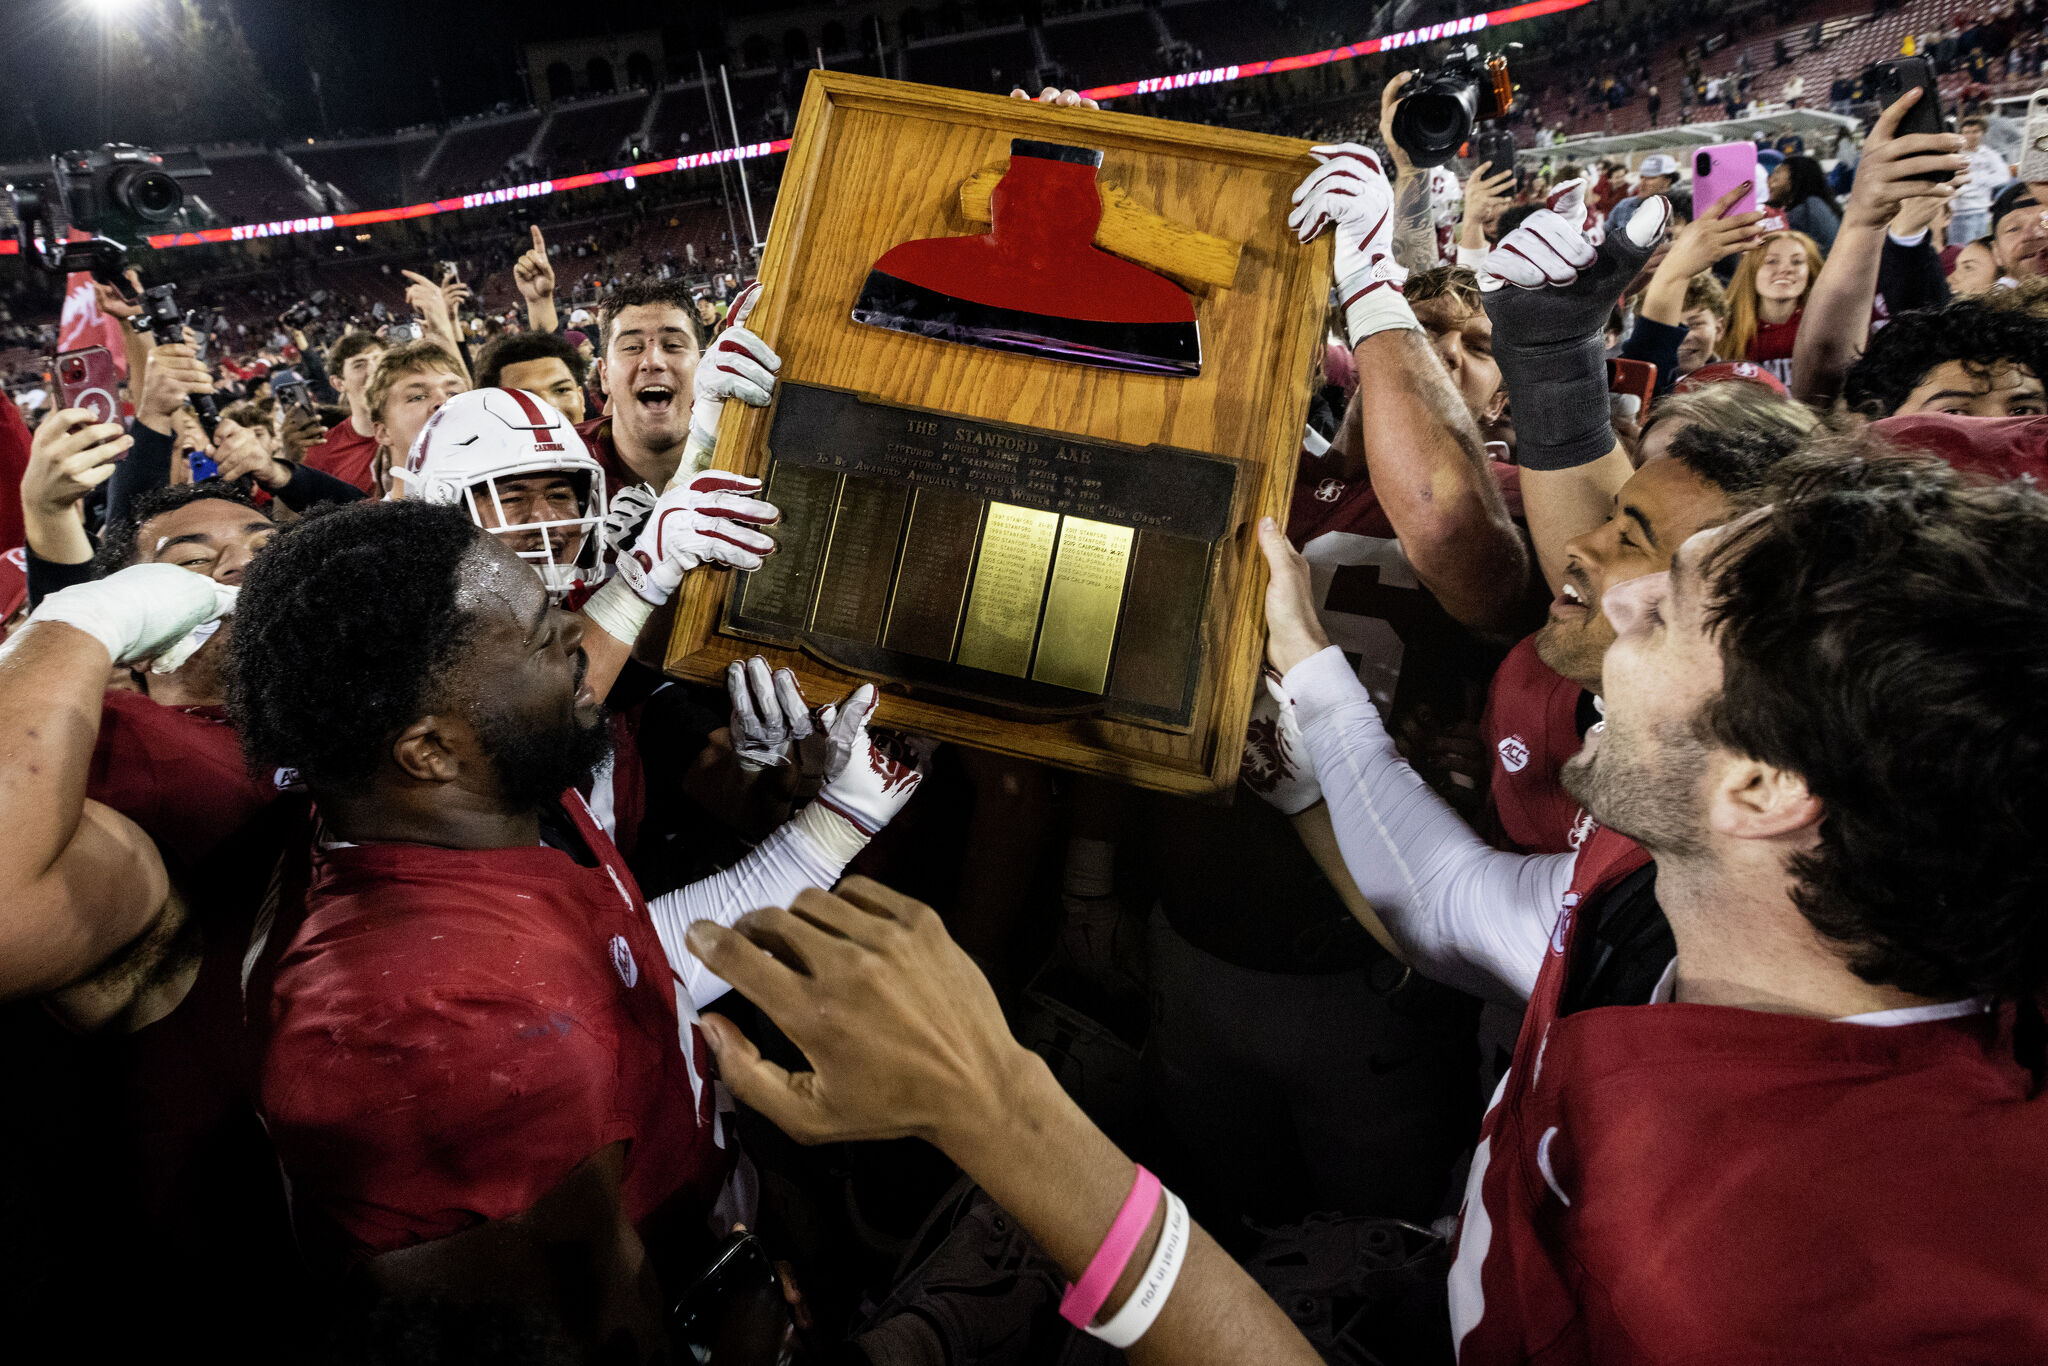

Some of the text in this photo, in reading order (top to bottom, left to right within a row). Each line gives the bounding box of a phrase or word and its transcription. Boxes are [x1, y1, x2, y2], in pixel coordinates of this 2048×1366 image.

[1380, 14, 1488, 52] STANFORD
[1138, 65, 1239, 94] STANFORD
[677, 142, 771, 170] STANFORD
[463, 181, 552, 208] STANFORD
[231, 216, 334, 241] STANFORD
[907, 418, 1092, 465] THE STANFORD AXE
[534, 443, 565, 452] CARDINAL
[942, 441, 978, 454] FORGED
[886, 442, 934, 458] CAPTURED
[941, 452, 954, 462] BY
[960, 456, 1017, 474] CALIFORNIA
[883, 453, 942, 471] RECAPTURED
[948, 465, 960, 475] BY
[968, 469, 1016, 486] STANFORD
[1006, 515, 1032, 524] STANFORD
[1004, 522, 1031, 532] STANFORD
[1003, 529, 1030, 539] STANFORD
[1079, 529, 1106, 539] STANFORD
[1001, 537, 1028, 547] STANFORD
[1078, 536, 1105, 545] STANFORD
[1000, 544, 1027, 554] STANFORD
[1077, 543, 1106, 553] CALIFORNIA
[998, 552, 1025, 561] CALIFORNIA
[1076, 549, 1104, 559] STANFORD
[996, 559, 1024, 569] CALIFORNIA
[1074, 556, 1105, 566] CALIFORNIA
[1070, 577, 1100, 587] CALIFORNIA
[1502, 743, 1527, 764] ACC
[1171, 1213, 1181, 1229] my
[1163, 1232, 1180, 1266] trust
[1155, 1266, 1168, 1281] in
